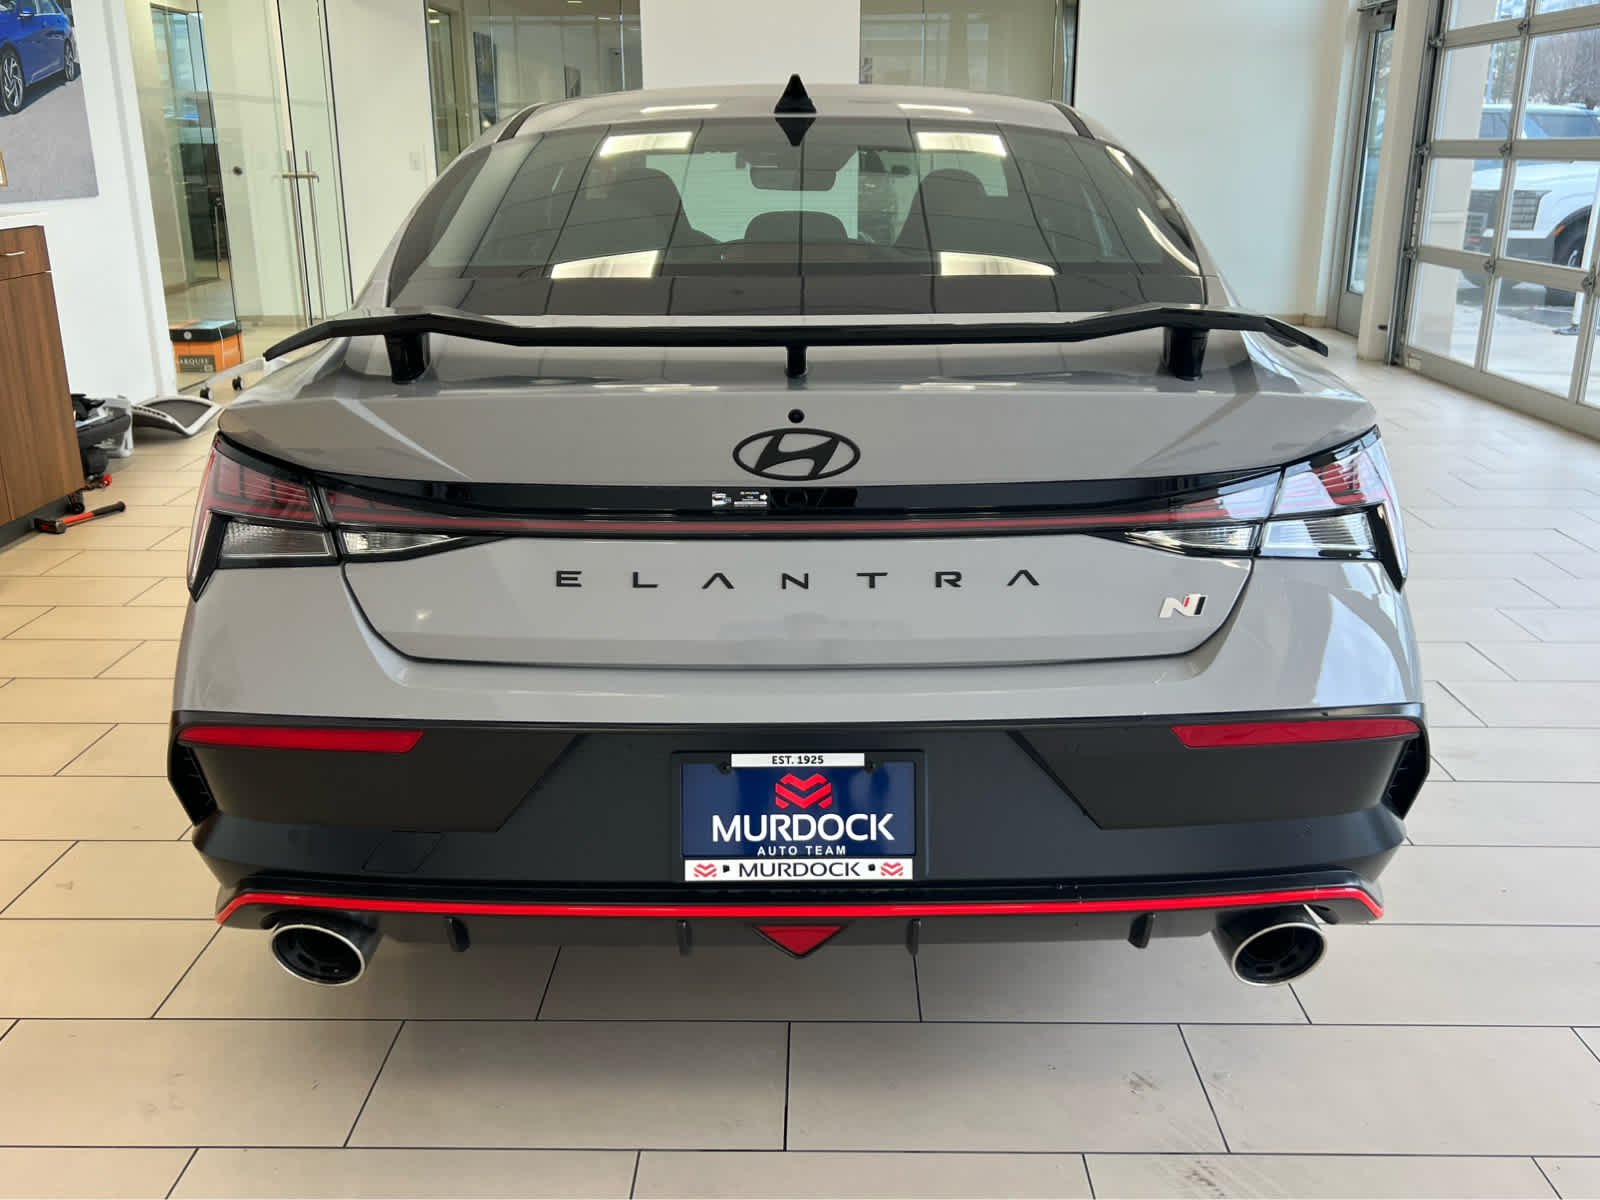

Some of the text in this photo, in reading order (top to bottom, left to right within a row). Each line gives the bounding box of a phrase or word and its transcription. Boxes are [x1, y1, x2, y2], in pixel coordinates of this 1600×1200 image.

[555, 569, 1040, 590] ELANTRA
[771, 755, 824, 765] EST. 1925
[712, 813, 895, 843] MURDOCK
[757, 845, 846, 856] AUTO TEAM
[738, 862, 861, 878] MURDOCK
